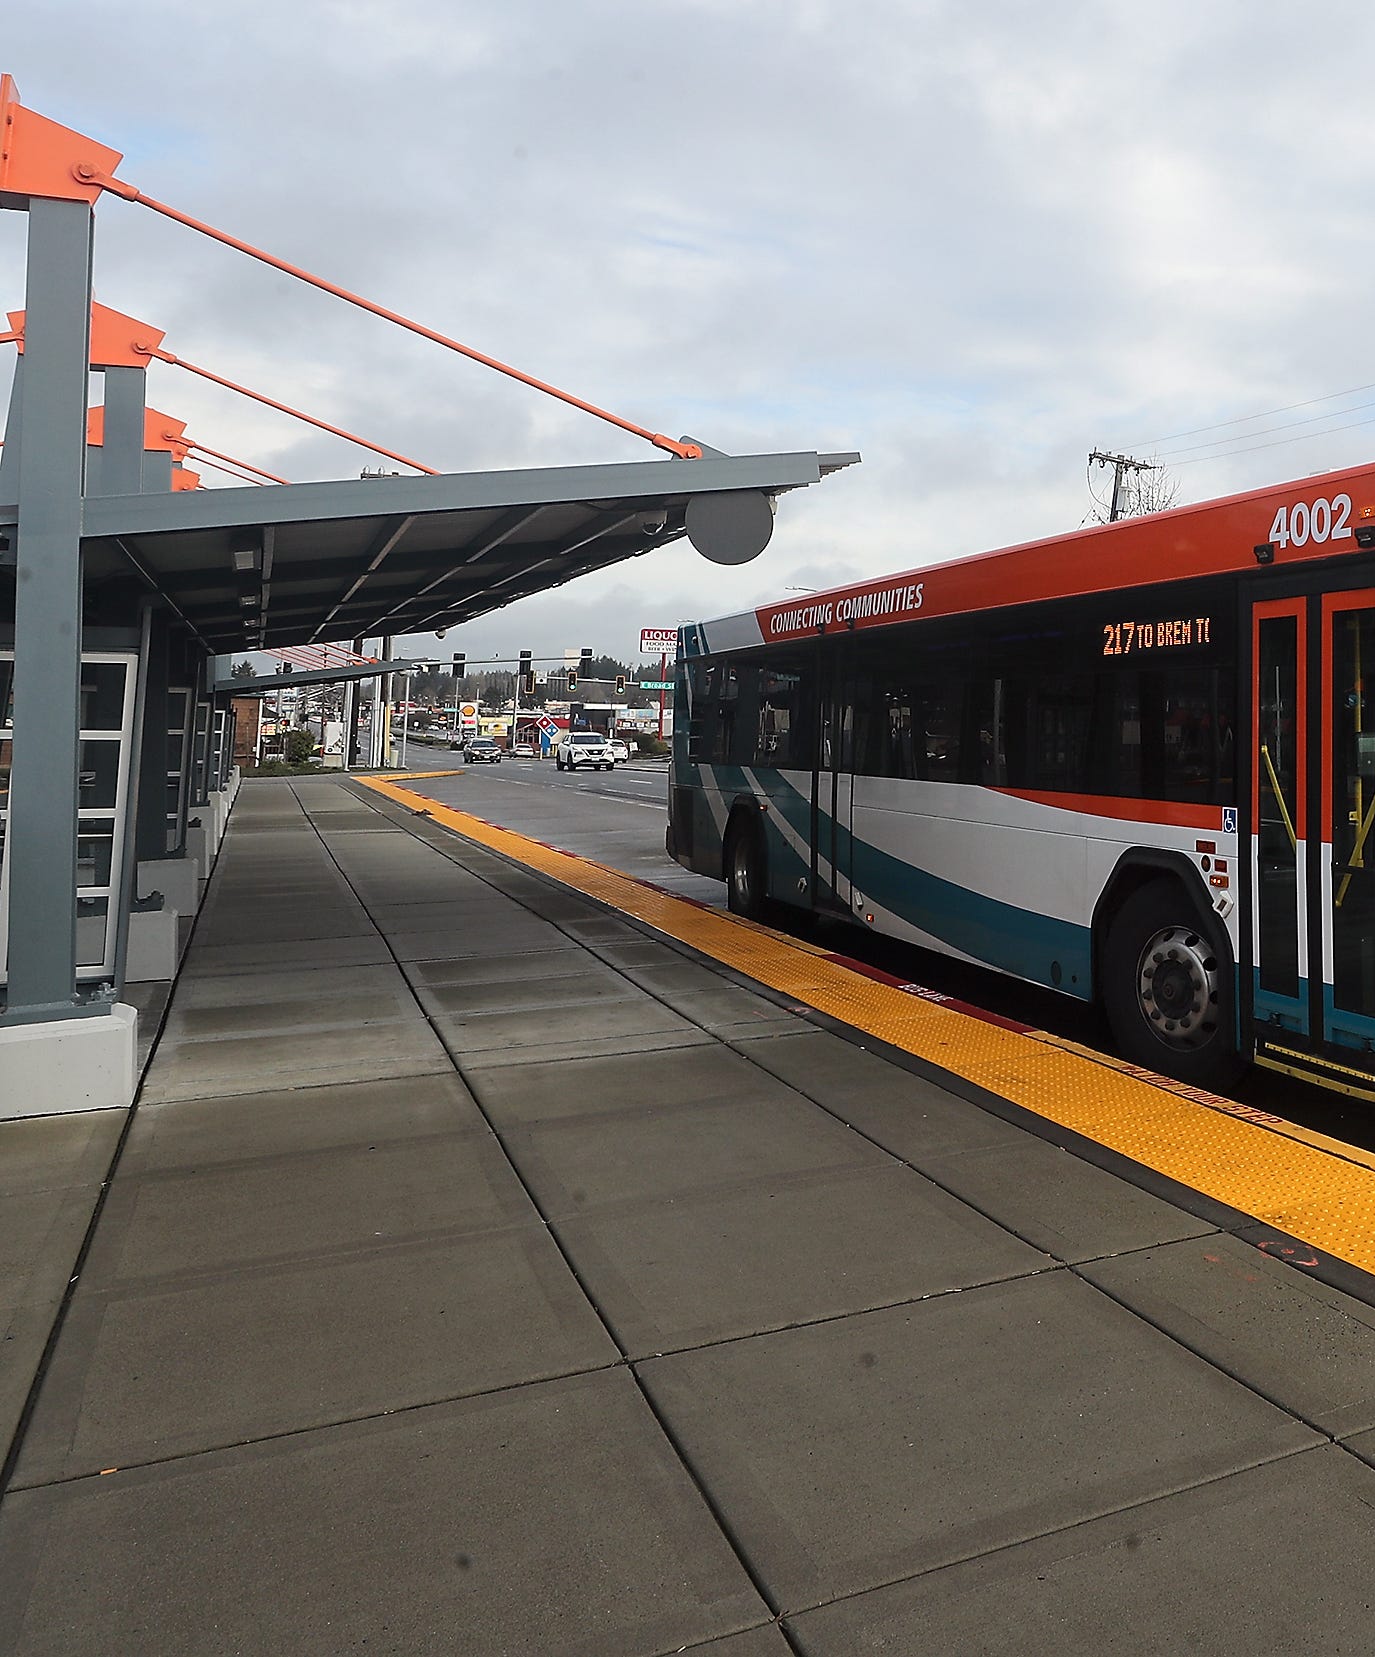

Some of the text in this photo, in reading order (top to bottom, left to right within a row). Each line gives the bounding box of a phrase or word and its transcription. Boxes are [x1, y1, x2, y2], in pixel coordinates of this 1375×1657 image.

[1269, 493, 1352, 549] 4002
[770, 583, 924, 634] CONNECTING COMMUNITIES
[644, 631, 678, 640] LIQUO
[1103, 622, 1135, 655] 217
[1136, 624, 1153, 648] TO
[1157, 620, 1191, 646] BREM
[1175, 1086, 1230, 1105] YOUR
[1222, 1105, 1283, 1124] STEP
